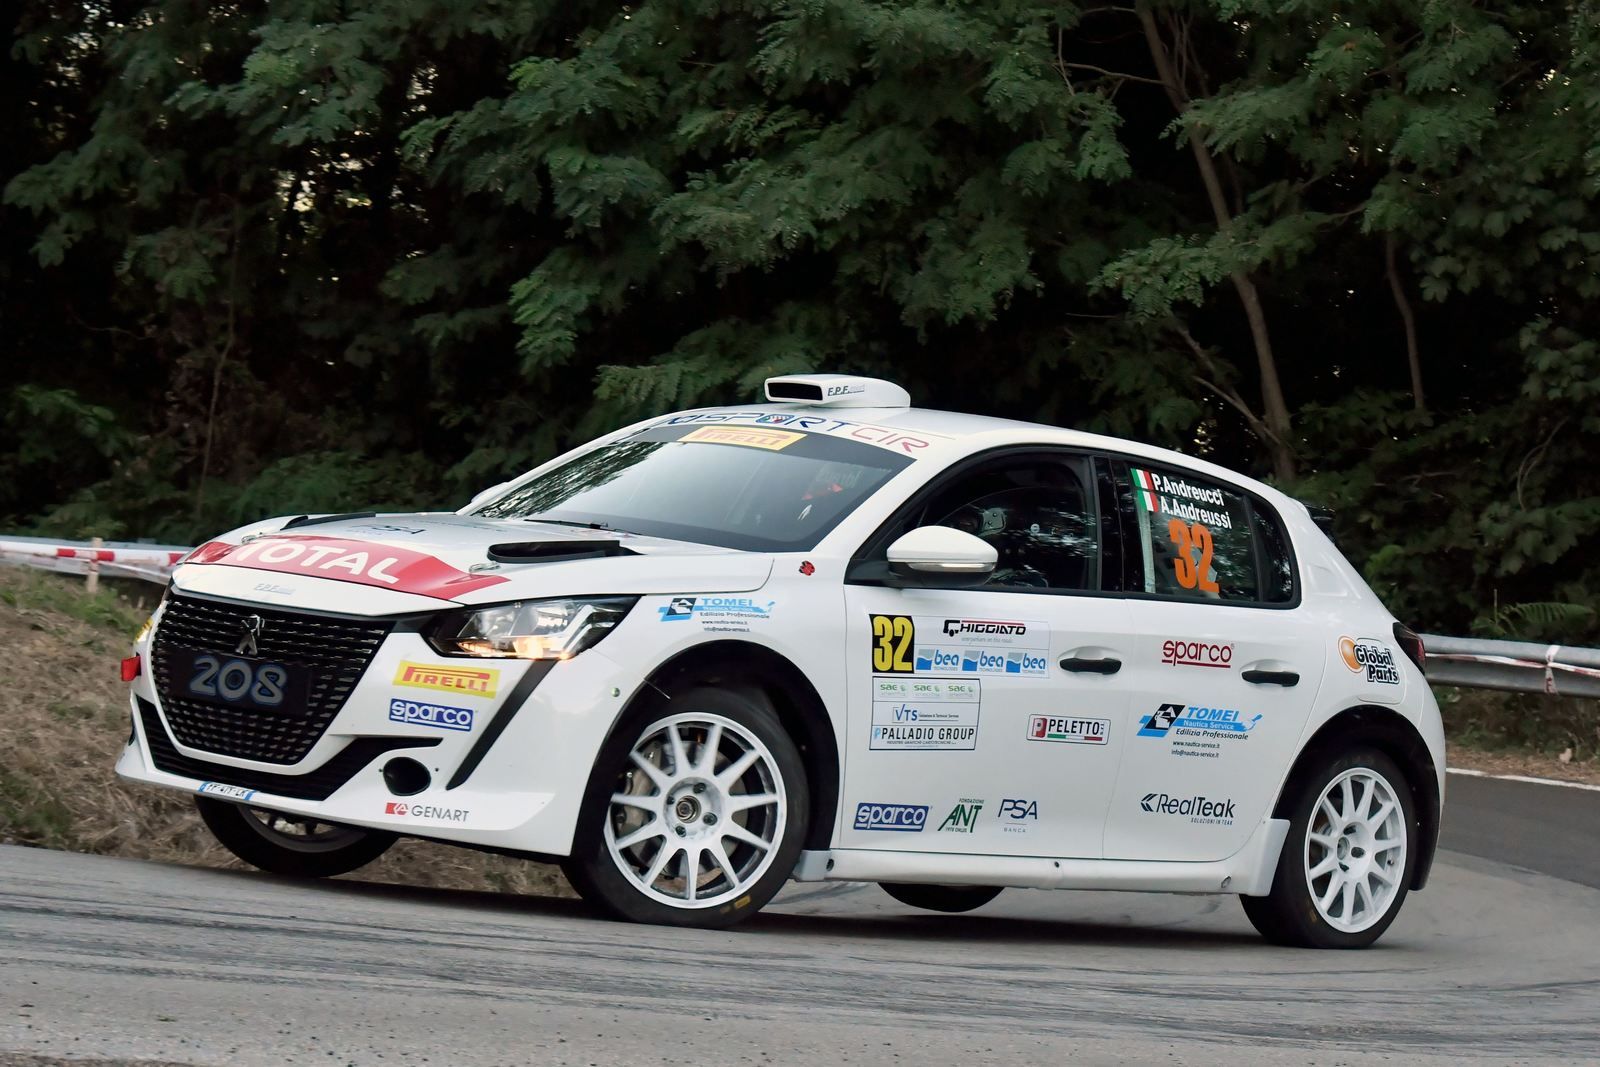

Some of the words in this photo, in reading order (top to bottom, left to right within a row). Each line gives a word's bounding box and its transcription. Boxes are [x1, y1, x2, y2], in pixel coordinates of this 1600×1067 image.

[698, 428, 786, 446] PIRELLI
[1151, 473, 1225, 506] P.Andreucci
[1160, 495, 1232, 529] A.Andreussi
[235, 538, 399, 585] TOTAL
[1168, 518, 1220, 593] 32
[701, 598, 753, 607] TOMEI
[943, 620, 1026, 637] CHIGGIATO
[872, 615, 914, 672] 32
[1162, 640, 1232, 666] sparco
[934, 650, 960, 666] bea
[980, 651, 1004, 668] bea
[1022, 653, 1046, 670] bea
[1355, 646, 1394, 666] Global
[189, 655, 287, 705] 208
[402, 667, 490, 692] PIRELLI
[1367, 664, 1399, 682] Parts
[391, 701, 472, 726] sparco
[895, 704, 918, 721] VTS
[1187, 706, 1240, 721] TOMEI
[881, 727, 934, 740] PALLADIO
[939, 728, 975, 740] GROUP
[1048, 719, 1100, 735] PELETTO
[1176, 728, 1200, 736] Edilizia
[1202, 730, 1249, 740] Professionale
[1184, 720, 1208, 728] Nautica
[1209, 721, 1234, 730] Service
[1171, 749, 1219, 758] info@nautica-service.it
[1172, 740, 1220, 748] www.nautica-service.it
[411, 805, 469, 821] GENART
[998, 799, 1037, 820] PSA
[1156, 794, 1236, 818] RealTeak
[857, 805, 927, 828] sparco
[937, 804, 982, 833] ANT
